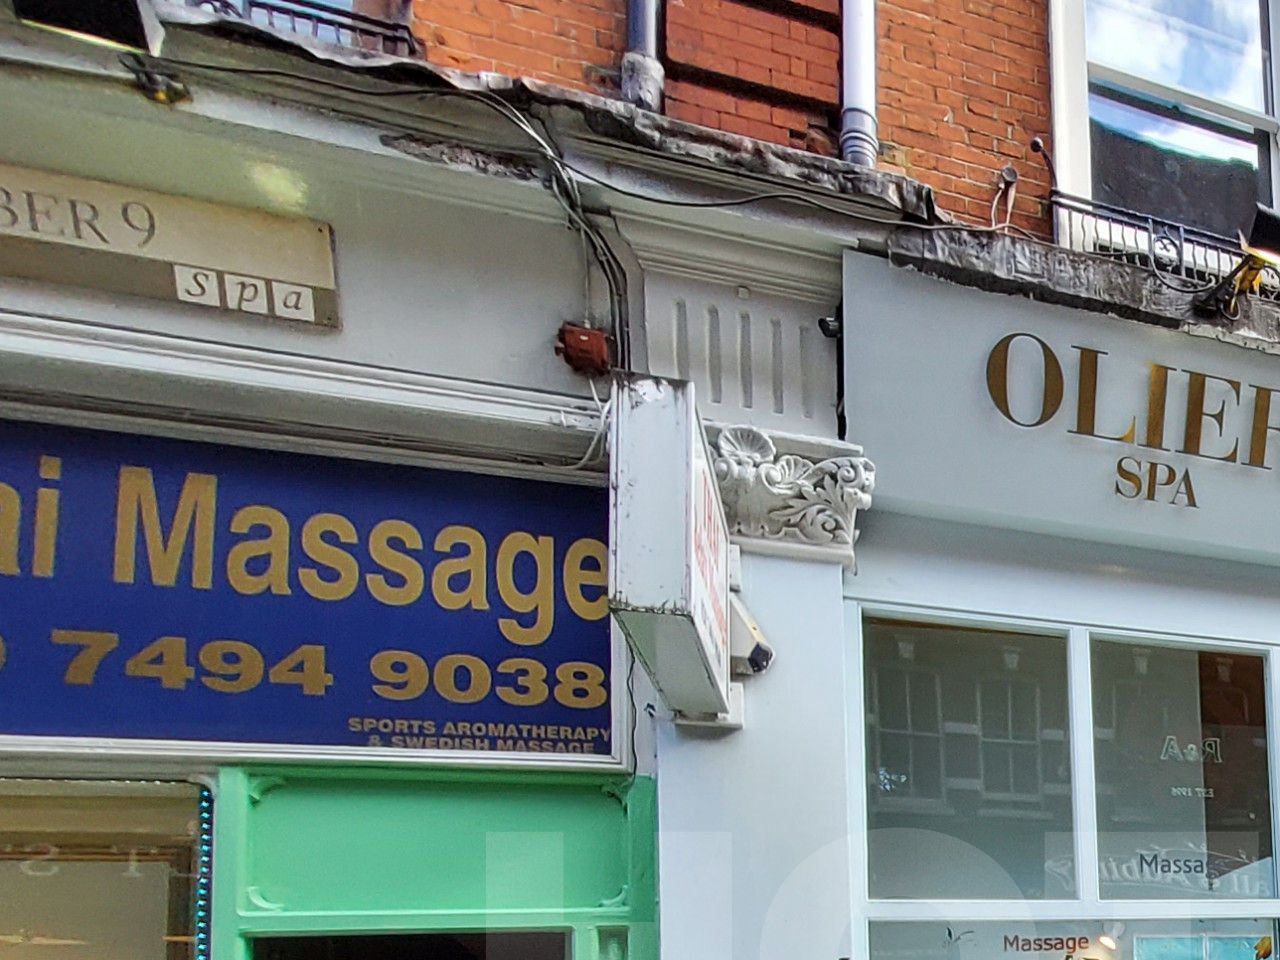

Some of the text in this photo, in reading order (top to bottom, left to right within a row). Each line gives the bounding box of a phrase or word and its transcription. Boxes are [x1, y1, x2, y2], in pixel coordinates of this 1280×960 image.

[121, 201, 156, 248] 9
[185, 272, 303, 311] spa
[1115, 456, 1199, 509] SPA
[113, 466, 610, 646] Massage
[51, 629, 334, 696] 7494
[370, 649, 609, 709] 9038
[347, 718, 612, 741] SPORTS AROMATHERAPY
[368, 735, 595, 754] & SWEDISH MASSAGE
[1003, 934, 1090, 954] Massage
